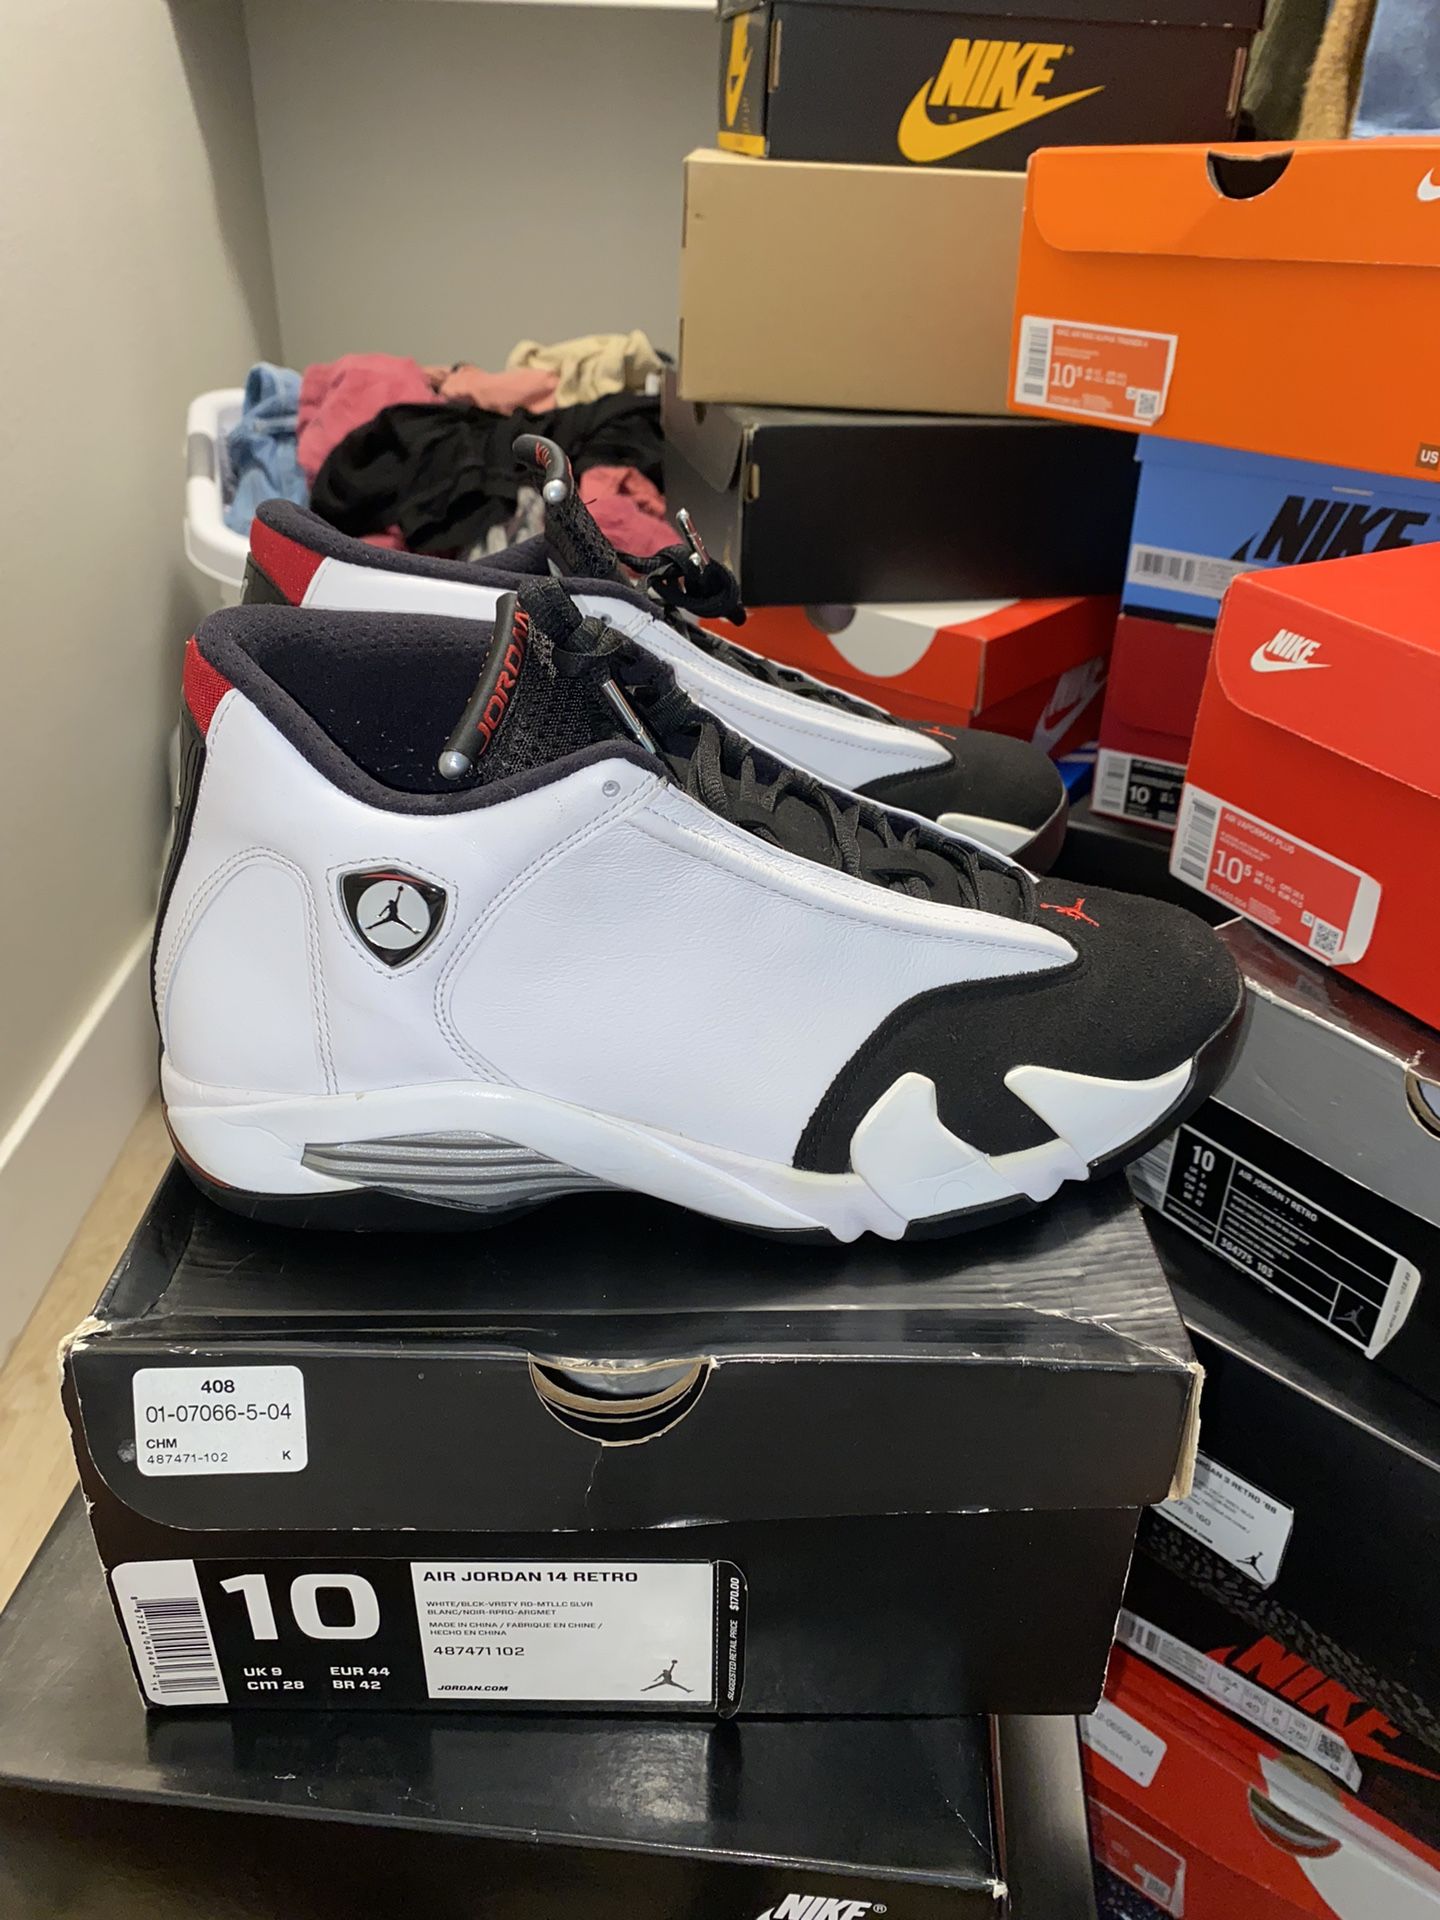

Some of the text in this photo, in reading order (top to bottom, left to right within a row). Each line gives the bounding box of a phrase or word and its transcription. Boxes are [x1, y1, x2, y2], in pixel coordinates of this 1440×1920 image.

[927, 38, 1066, 109] NIKE
[1419, 448, 1440, 465] US
[1266, 628, 1322, 665] NIKE
[1191, 1145, 1216, 1173] 10
[1252, 1176, 1285, 1203] JORDAN
[1289, 1200, 1319, 1224] RETRO
[200, 1379, 235, 1394] 408
[145, 1402, 292, 1424] 01-07066-5-04
[146, 1438, 178, 1450] CHM
[146, 1452, 229, 1465] 487471-102
[282, 1450, 292, 1461] K
[423, 1571, 638, 1582] AIR JORDAN 14 RETRO
[219, 1574, 380, 1640] 10
[727, 1577, 740, 1701] SUGGESTED RETAIL PRICE $170.00
[243, 1667, 283, 1677] UK 9
[329, 1666, 391, 1676] EUR 44
[282, 1680, 305, 1690] 28
[332, 1680, 382, 1690] BR 42
[773, 1893, 872, 1920] NIKE
